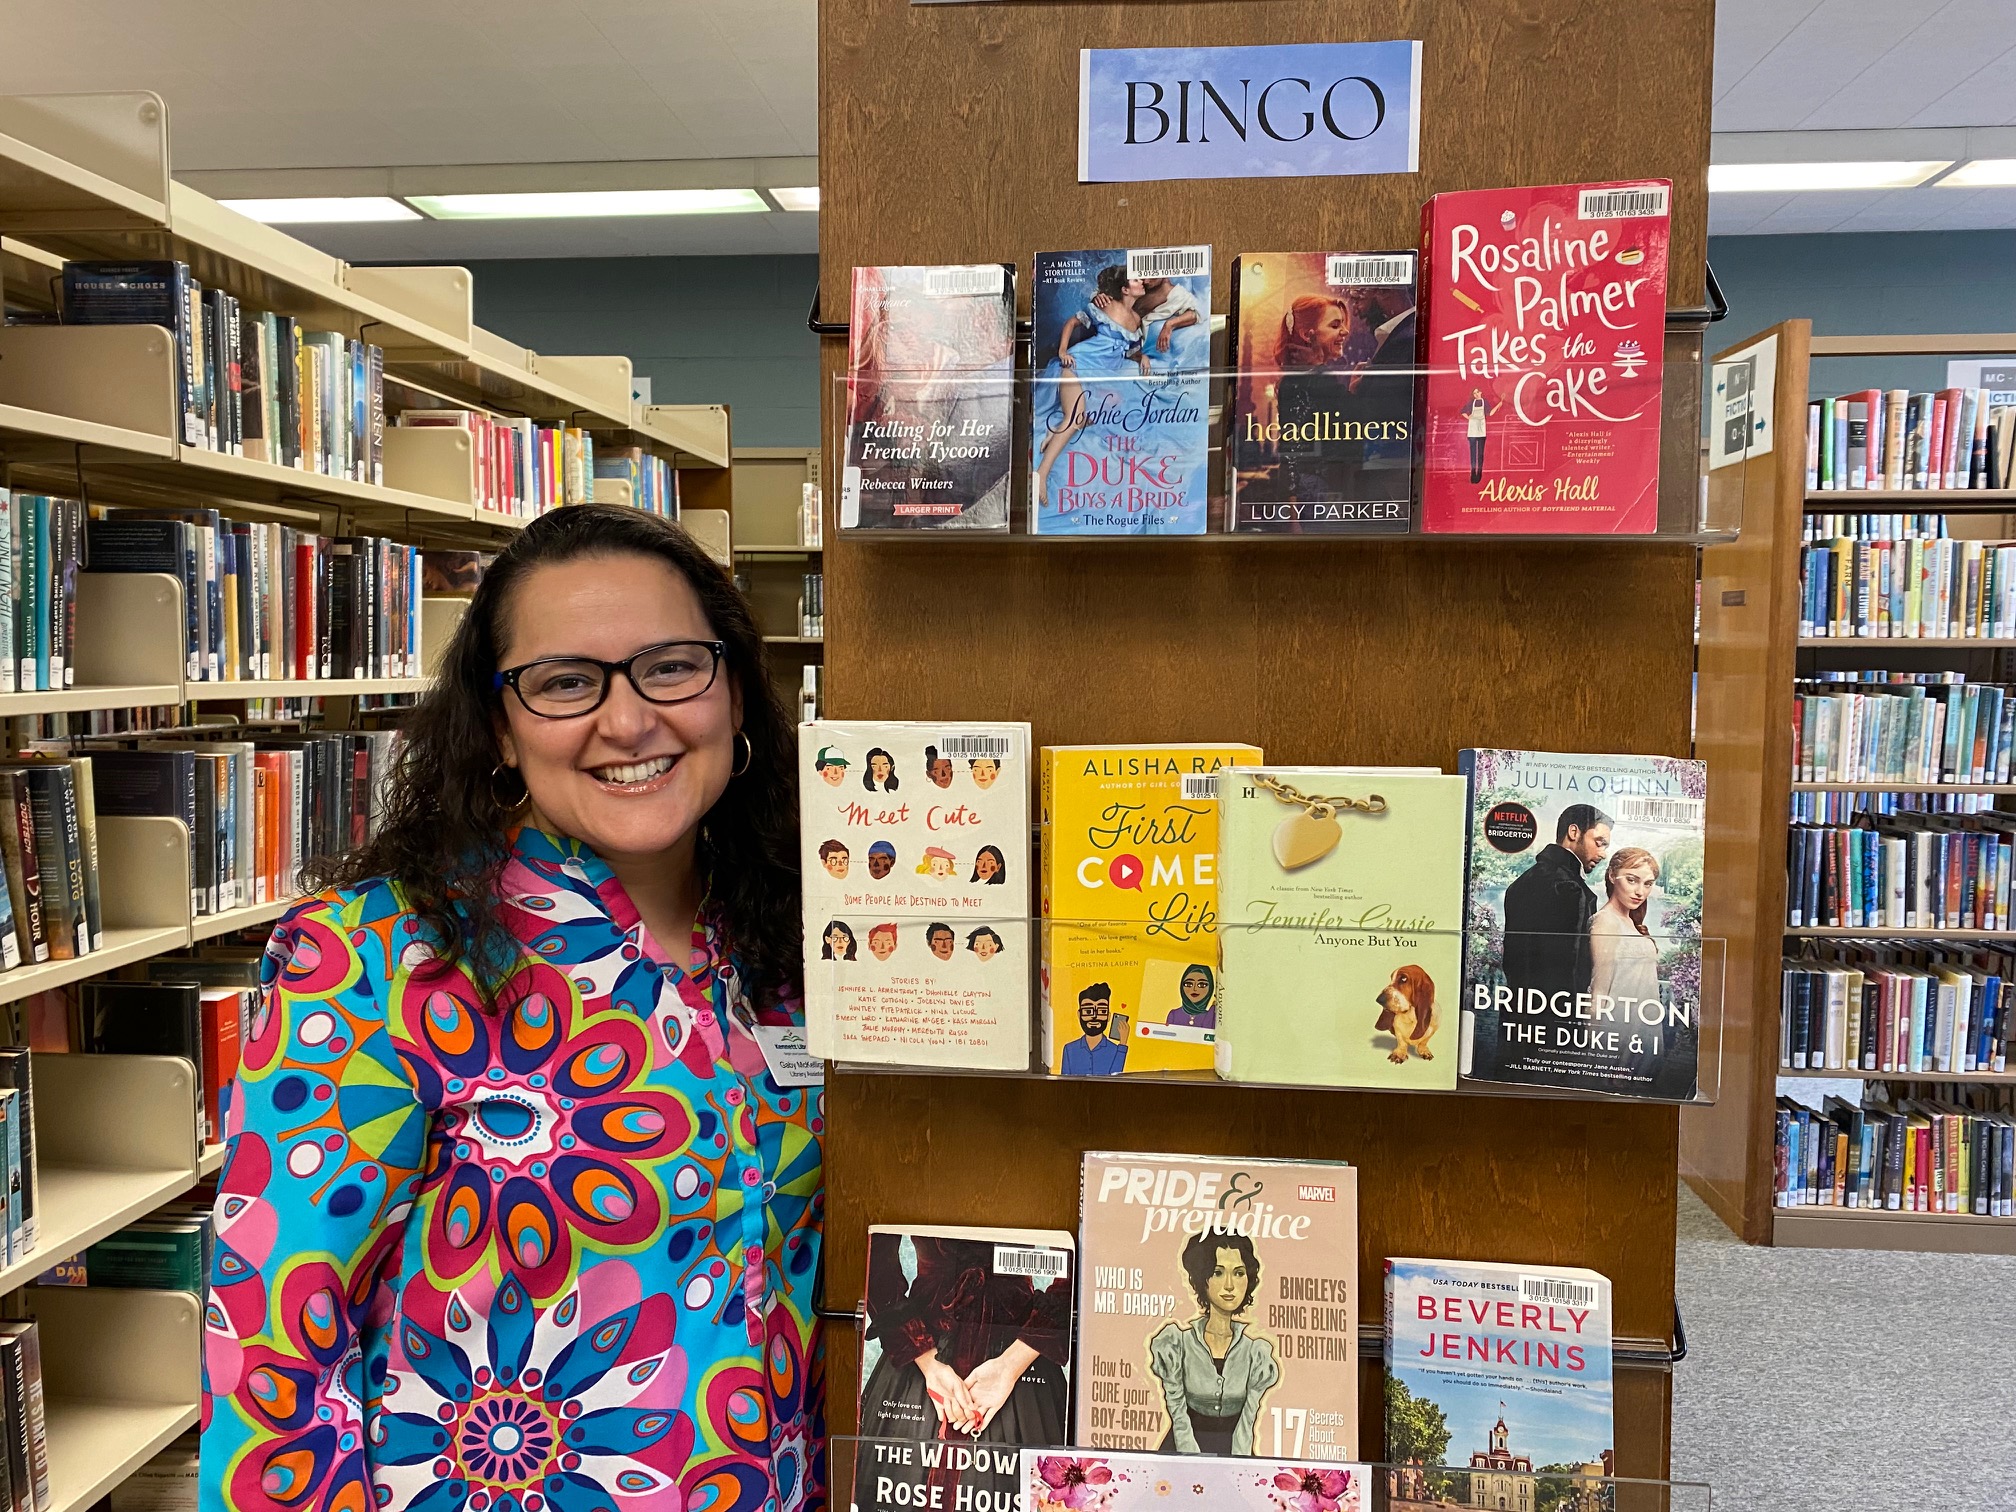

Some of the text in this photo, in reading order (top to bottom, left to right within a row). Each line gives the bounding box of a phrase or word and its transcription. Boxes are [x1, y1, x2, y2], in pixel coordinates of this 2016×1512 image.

[1123, 76, 1386, 144] BINGO
[1057, 260, 1082, 268] MASTER
[1451, 215, 1609, 292] Rosaline
[864, 293, 912, 311] Romance
[1514, 272, 1650, 332] Palmer
[183, 284, 194, 402] HOUSE ECHOES
[229, 316, 237, 348] DEATH
[1442, 324, 1596, 380] Takes the
[1514, 367, 1643, 426] Cake
[862, 419, 994, 441] Falling for Her
[1046, 389, 1199, 444] Sophie Jordan
[1245, 411, 1408, 442] headliners
[861, 442, 990, 463] French Tycoon
[1105, 435, 1141, 452] THE
[860, 478, 954, 490] Rebecca Winters
[1067, 451, 1183, 489] DUKE
[1058, 487, 1189, 513] BUYS A BRIDE
[1478, 475, 1600, 502] Alexis Hall
[900, 506, 955, 514] LARGER PRINT
[1083, 515, 1164, 527] The Rogue Files
[1251, 503, 1399, 520] LUCY PARKER
[1844, 559, 1852, 586] FARM
[1859, 595, 1868, 618] LIVING
[1083, 756, 1234, 777] ALISHA RAI
[68, 781, 76, 811] LAST
[1511, 770, 1669, 796] JULIA QUINN
[19, 802, 31, 854] DOETSCH
[63, 788, 74, 844] WISDOM
[838, 801, 982, 831] Meet Cute
[1088, 802, 1211, 850] First
[1494, 811, 1528, 823] NETFLIX
[1488, 829, 1533, 839] BRIDGERTON
[90, 846, 98, 871] DOIG
[1967, 838, 1978, 877] SHIVER
[69, 859, 79, 901] DOIG
[1076, 853, 1215, 893] COME
[844, 894, 983, 907] SOME PEOPLE ARE DESTINED TO MEET
[30, 903, 41, 941] HOUR
[1146, 892, 1217, 941] Lik
[1246, 900, 1435, 936] Jennifer Crusie
[1315, 933, 1418, 948] Anyone But You
[891, 977, 919, 985] STORIES
[963, 990, 992, 998] CLAYTON
[1474, 983, 1690, 1028] BRIDGERTON
[1503, 1022, 1659, 1055] THE DUKE & I
[1949, 1120, 1958, 1173] CLOSE CALL
[1097, 1166, 1264, 1211] PRIDE &
[1299, 1186, 1335, 1202] MARVEL
[1140, 1202, 1312, 1244] prejudice
[1094, 1266, 1144, 1291] WHO IS
[1279, 1276, 1347, 1304] BINGLEYS
[1432, 1278, 1519, 1291] USA TODAY BESTSELL
[1094, 1290, 1175, 1318] MR. DARCY?
[1417, 1294, 1590, 1334] BEVERLY
[1571, 1299, 1588, 1307] 3317
[1268, 1304, 1347, 1333] BRING BLING
[1276, 1334, 1347, 1362] TO BRITAIN
[1419, 1332, 1586, 1372] JENKINS
[1021, 1376, 1046, 1384] NOVEL
[1092, 1355, 1132, 1379] How to
[14, 1343, 28, 1455] WEDDING STATION
[882, 1400, 897, 1409] Only
[898, 1401, 910, 1409] love
[1091, 1382, 1151, 1407] CURE your
[29, 1378, 47, 1469] HE STARTED
[877, 1410, 891, 1419] light
[901, 1412, 911, 1420] the
[912, 1414, 926, 1422] dark
[1090, 1407, 1163, 1433] BOY-CRAZY
[1309, 1409, 1344, 1427] Secrets
[1090, 1433, 1147, 1450] SISTERS!
[1271, 1406, 1308, 1458] 17
[1309, 1426, 1335, 1444] About
[874, 1441, 1019, 1476] THE WIDOW
[1309, 1443, 1348, 1461] SUMMER
[876, 1476, 1021, 1512] ROSE HOUS
